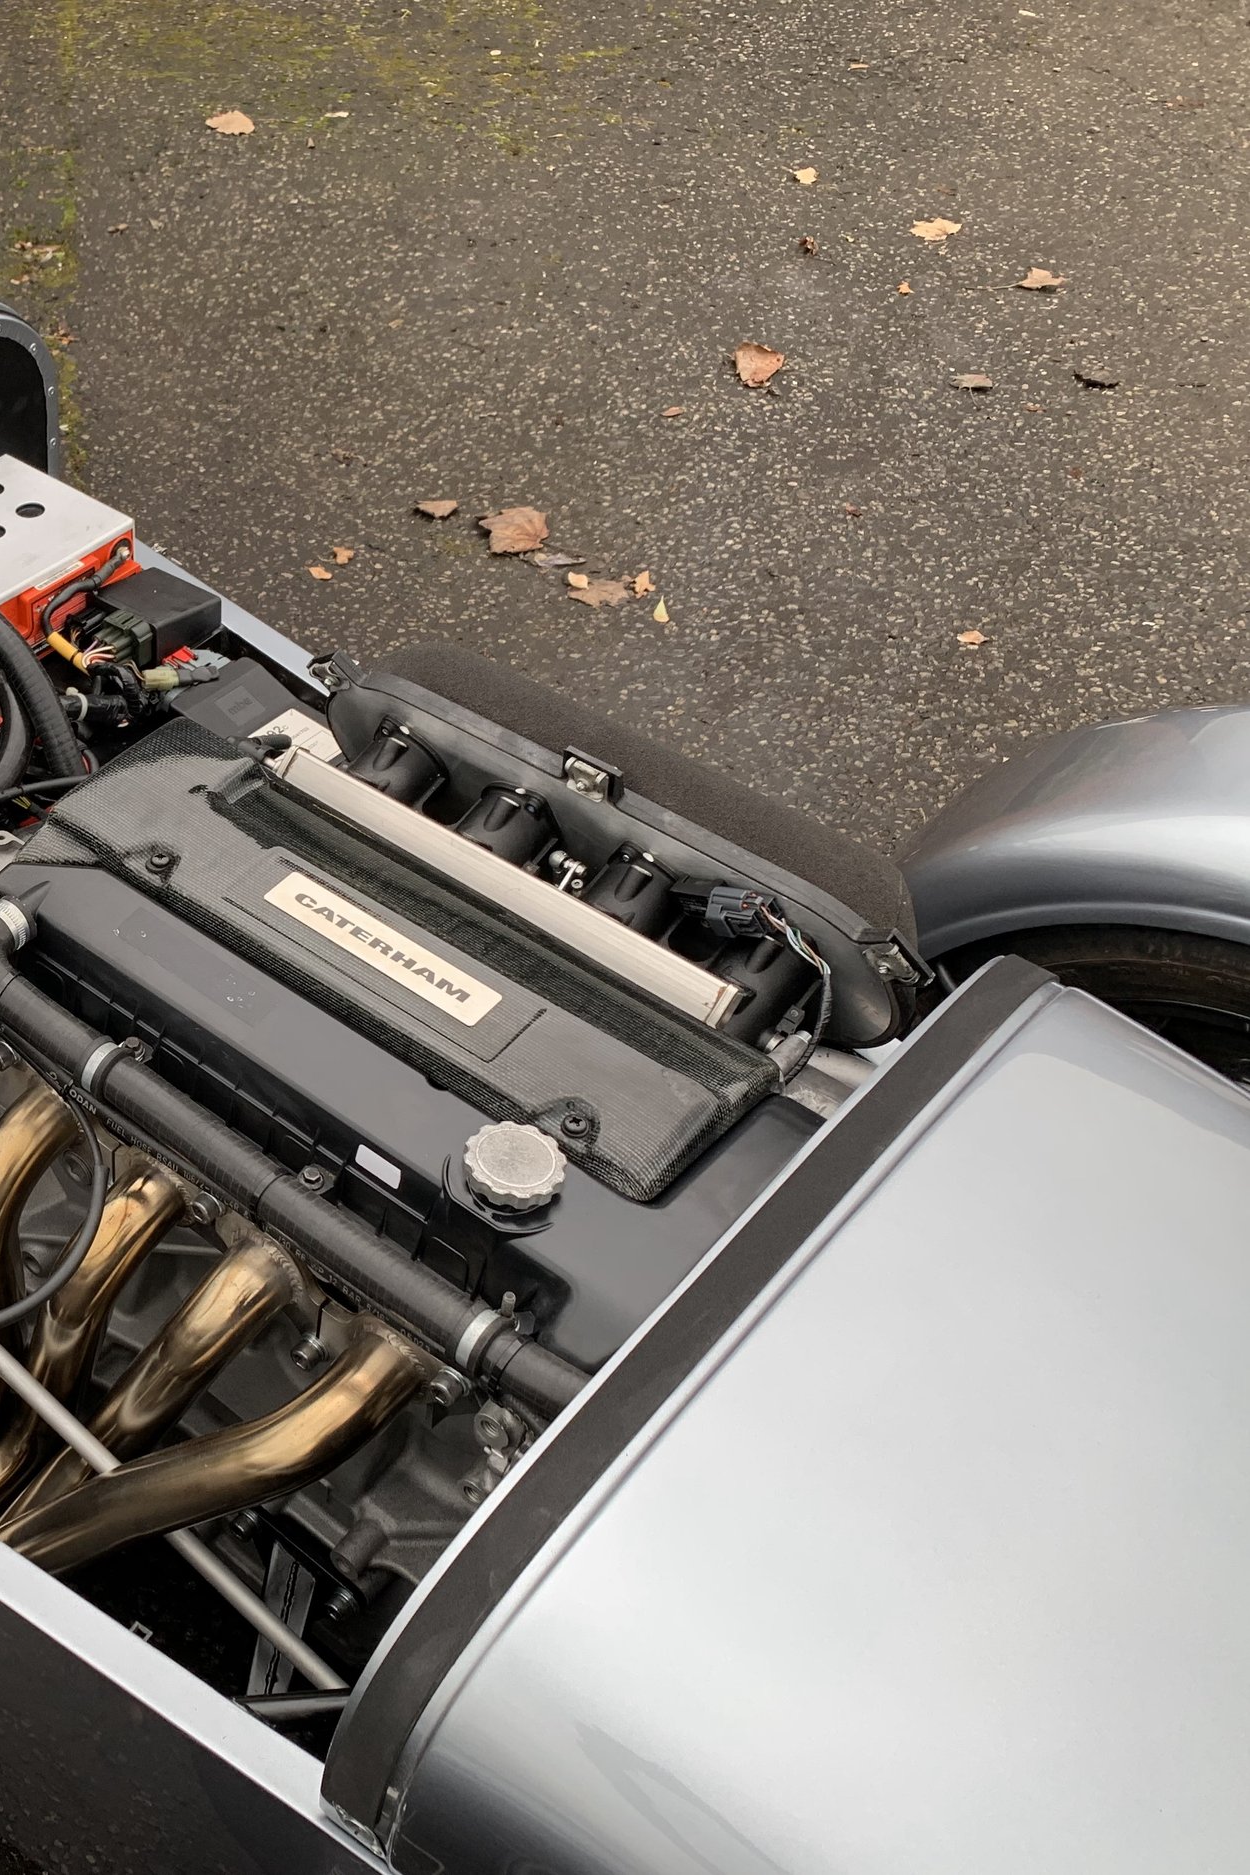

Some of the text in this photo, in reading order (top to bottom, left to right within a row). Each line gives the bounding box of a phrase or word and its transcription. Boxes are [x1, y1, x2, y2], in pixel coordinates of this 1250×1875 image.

[294, 892, 471, 1003] CATERHAM
[67, 1087, 97, 1114] ODAN
[106, 1118, 127, 1137] FUEL
[131, 1136, 152, 1153] HOSE
[342, 1287, 361, 1303] BAR
